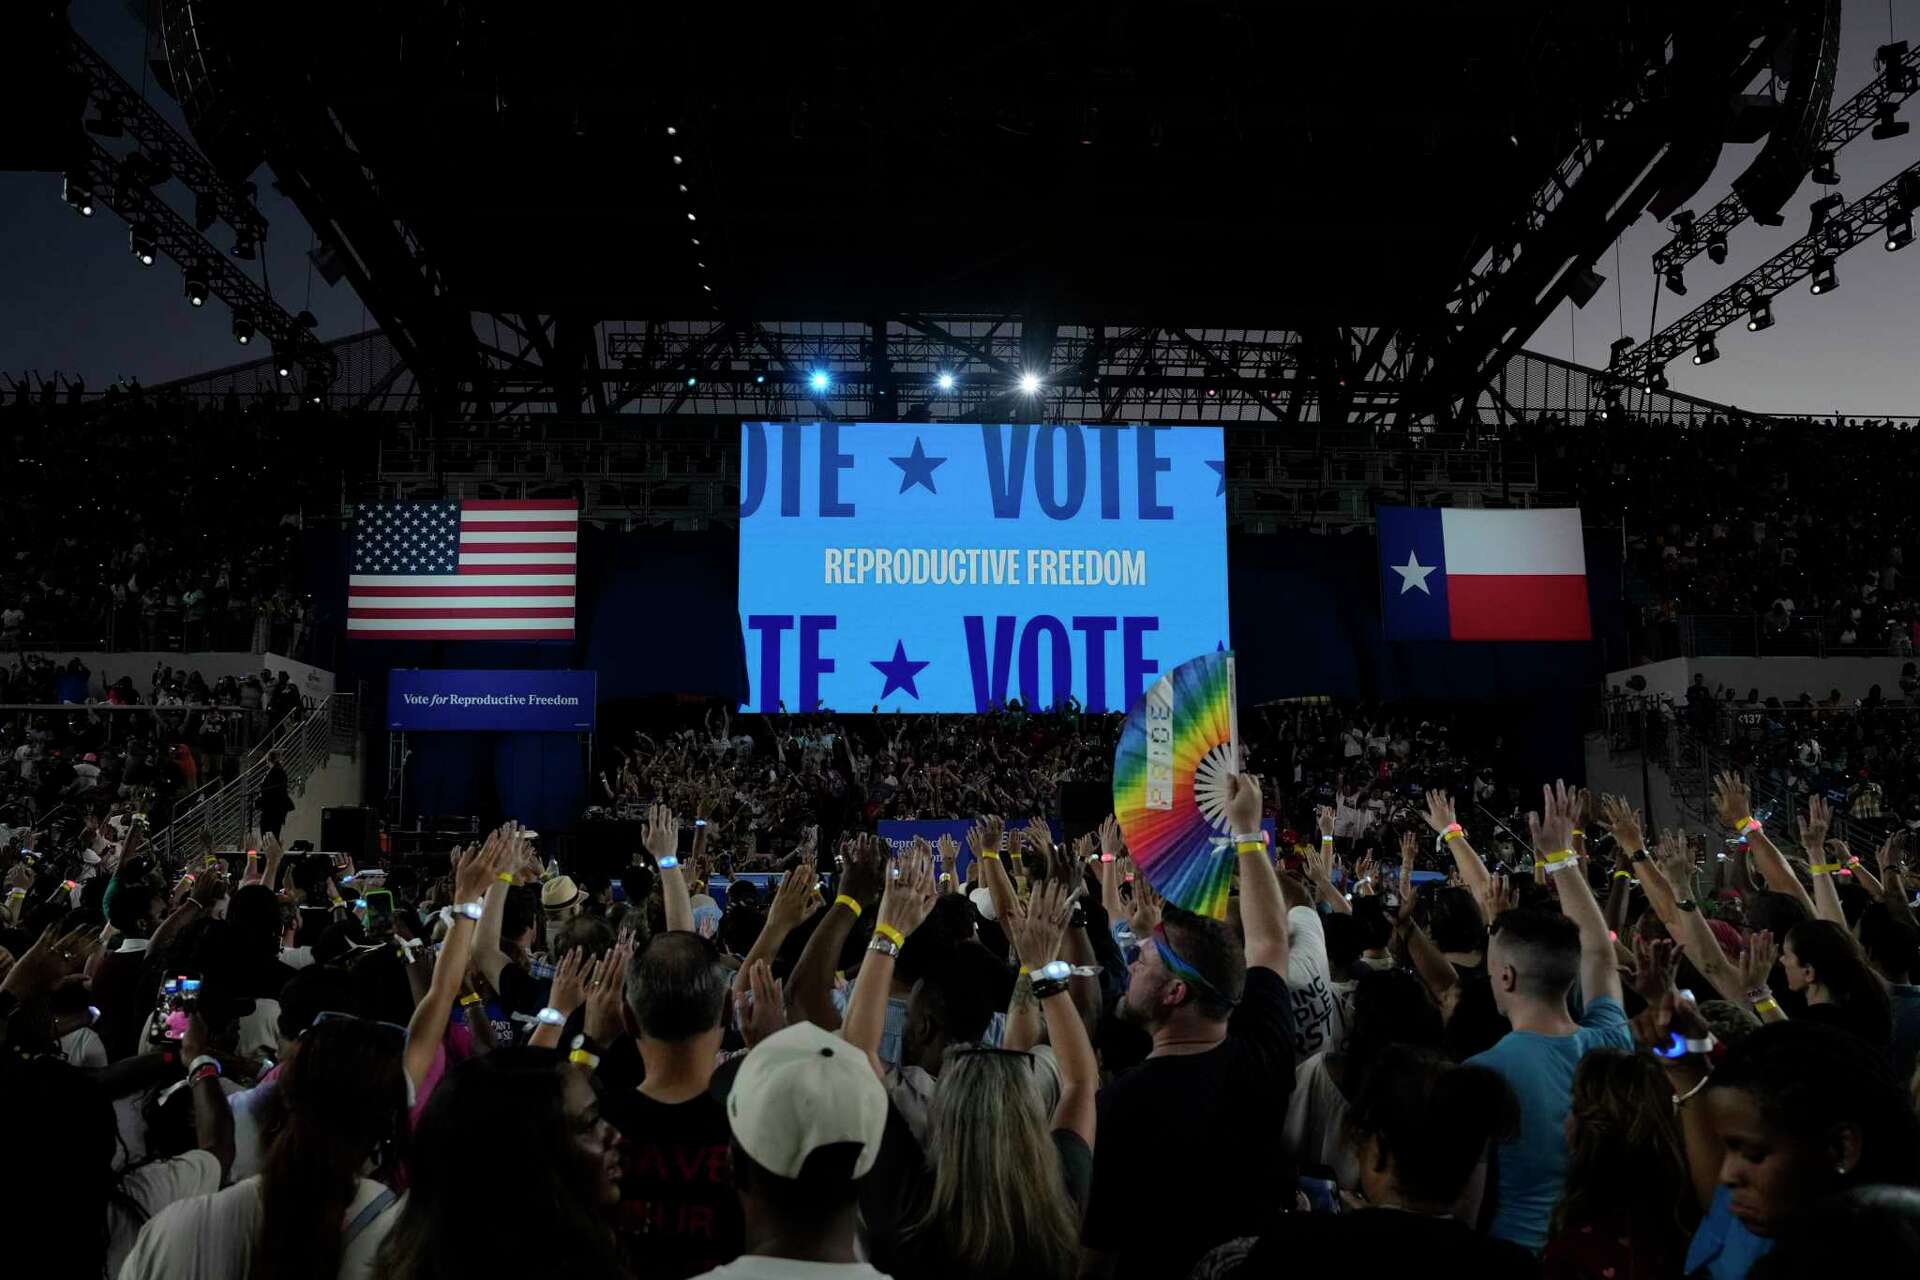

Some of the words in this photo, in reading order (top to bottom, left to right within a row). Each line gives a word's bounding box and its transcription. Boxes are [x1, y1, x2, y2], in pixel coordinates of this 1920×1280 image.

[981, 424, 1174, 520] VOTE
[824, 548, 1020, 585] REPRODUCTIVE
[1027, 549, 1146, 586] FREEDOM
[740, 615, 836, 713] TE
[964, 614, 1159, 714] VOTE
[403, 693, 429, 705] Vote
[428, 694, 449, 708] for
[450, 694, 526, 708] Reproductive
[528, 695, 579, 706] Freedom
[626, 1141, 728, 1185] AVE
